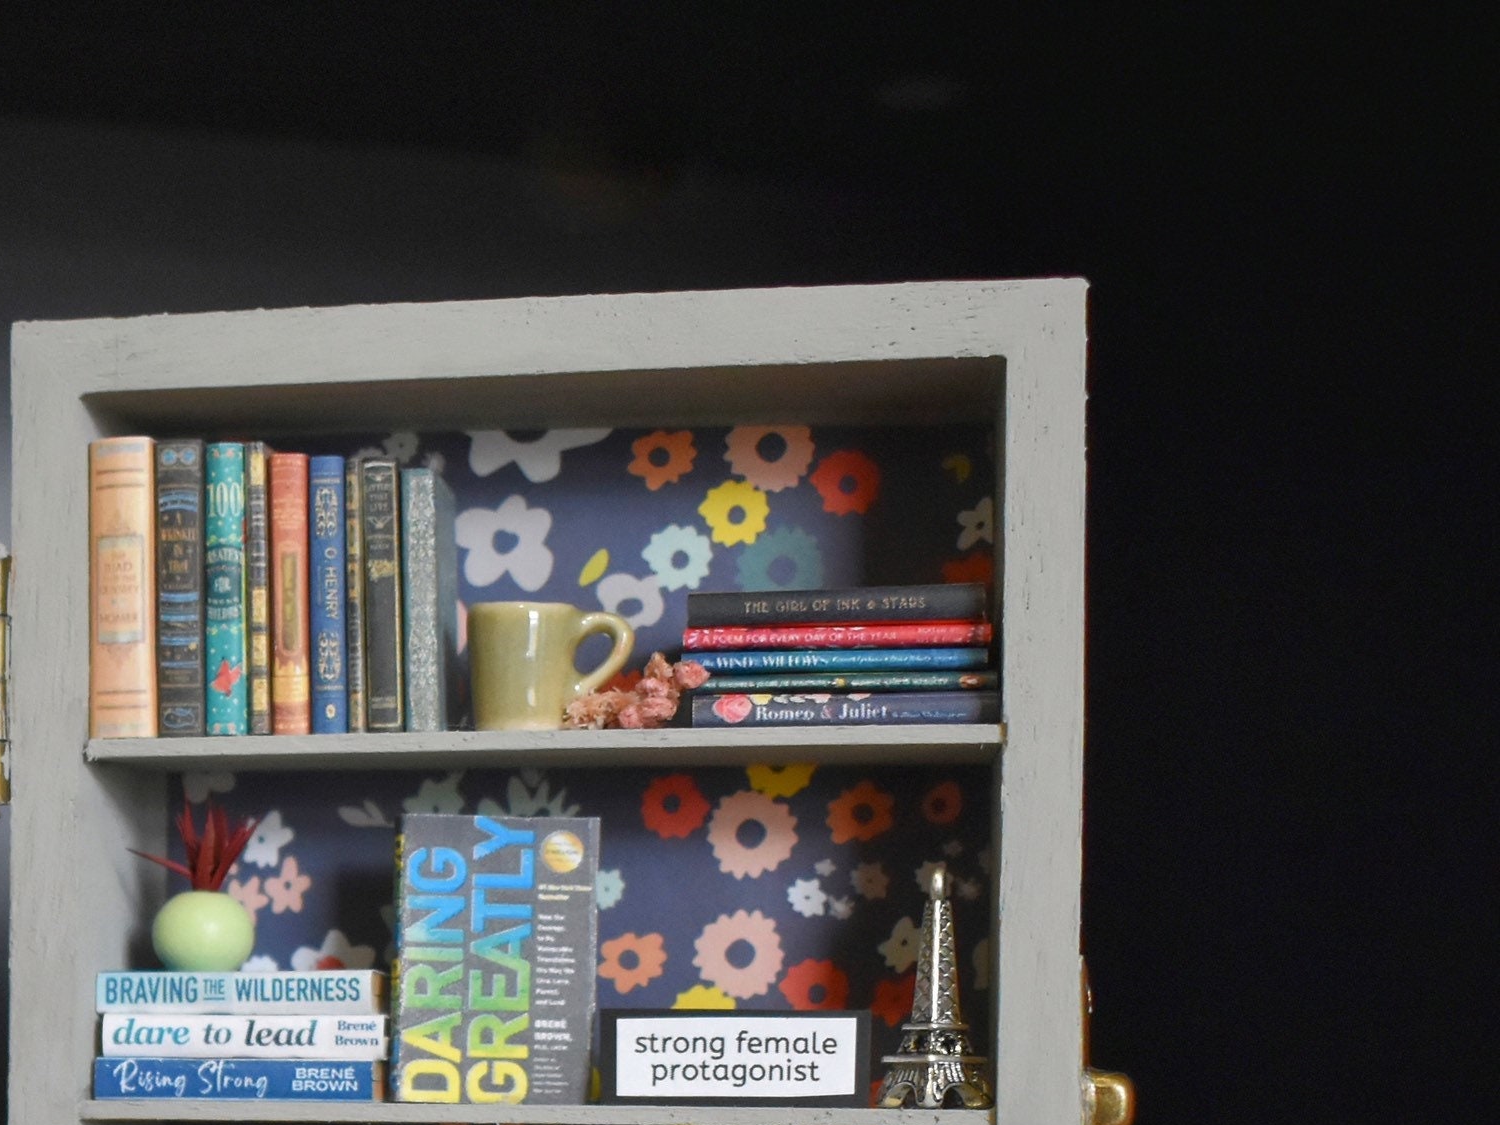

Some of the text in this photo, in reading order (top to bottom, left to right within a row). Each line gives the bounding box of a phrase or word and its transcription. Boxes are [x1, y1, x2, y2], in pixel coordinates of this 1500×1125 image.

[206, 482, 244, 518] 100
[325, 566, 340, 620] HENRY
[743, 601, 769, 614] THE
[775, 600, 807, 612] GIRL
[812, 599, 830, 611] OF
[836, 598, 860, 611] INK
[882, 597, 926, 610] STARS
[804, 632, 826, 642] DAY
[755, 703, 815, 720] Romeo
[820, 705, 833, 719] &
[838, 703, 888, 720] Juliet
[465, 815, 537, 1105] GREATLY
[400, 846, 468, 1103] DARING
[105, 976, 360, 1004] BRAVING THE WILDERNESS
[112, 1018, 318, 1046] dare to lead
[337, 1020, 377, 1031] Brené
[335, 1035, 379, 1046] Brown
[634, 1030, 838, 1060] strong female
[113, 1058, 268, 1098] Rising Strong
[291, 1080, 359, 1091] BROWN
[295, 1066, 356, 1080] BRENÉ
[651, 1059, 821, 1088] protagonist
